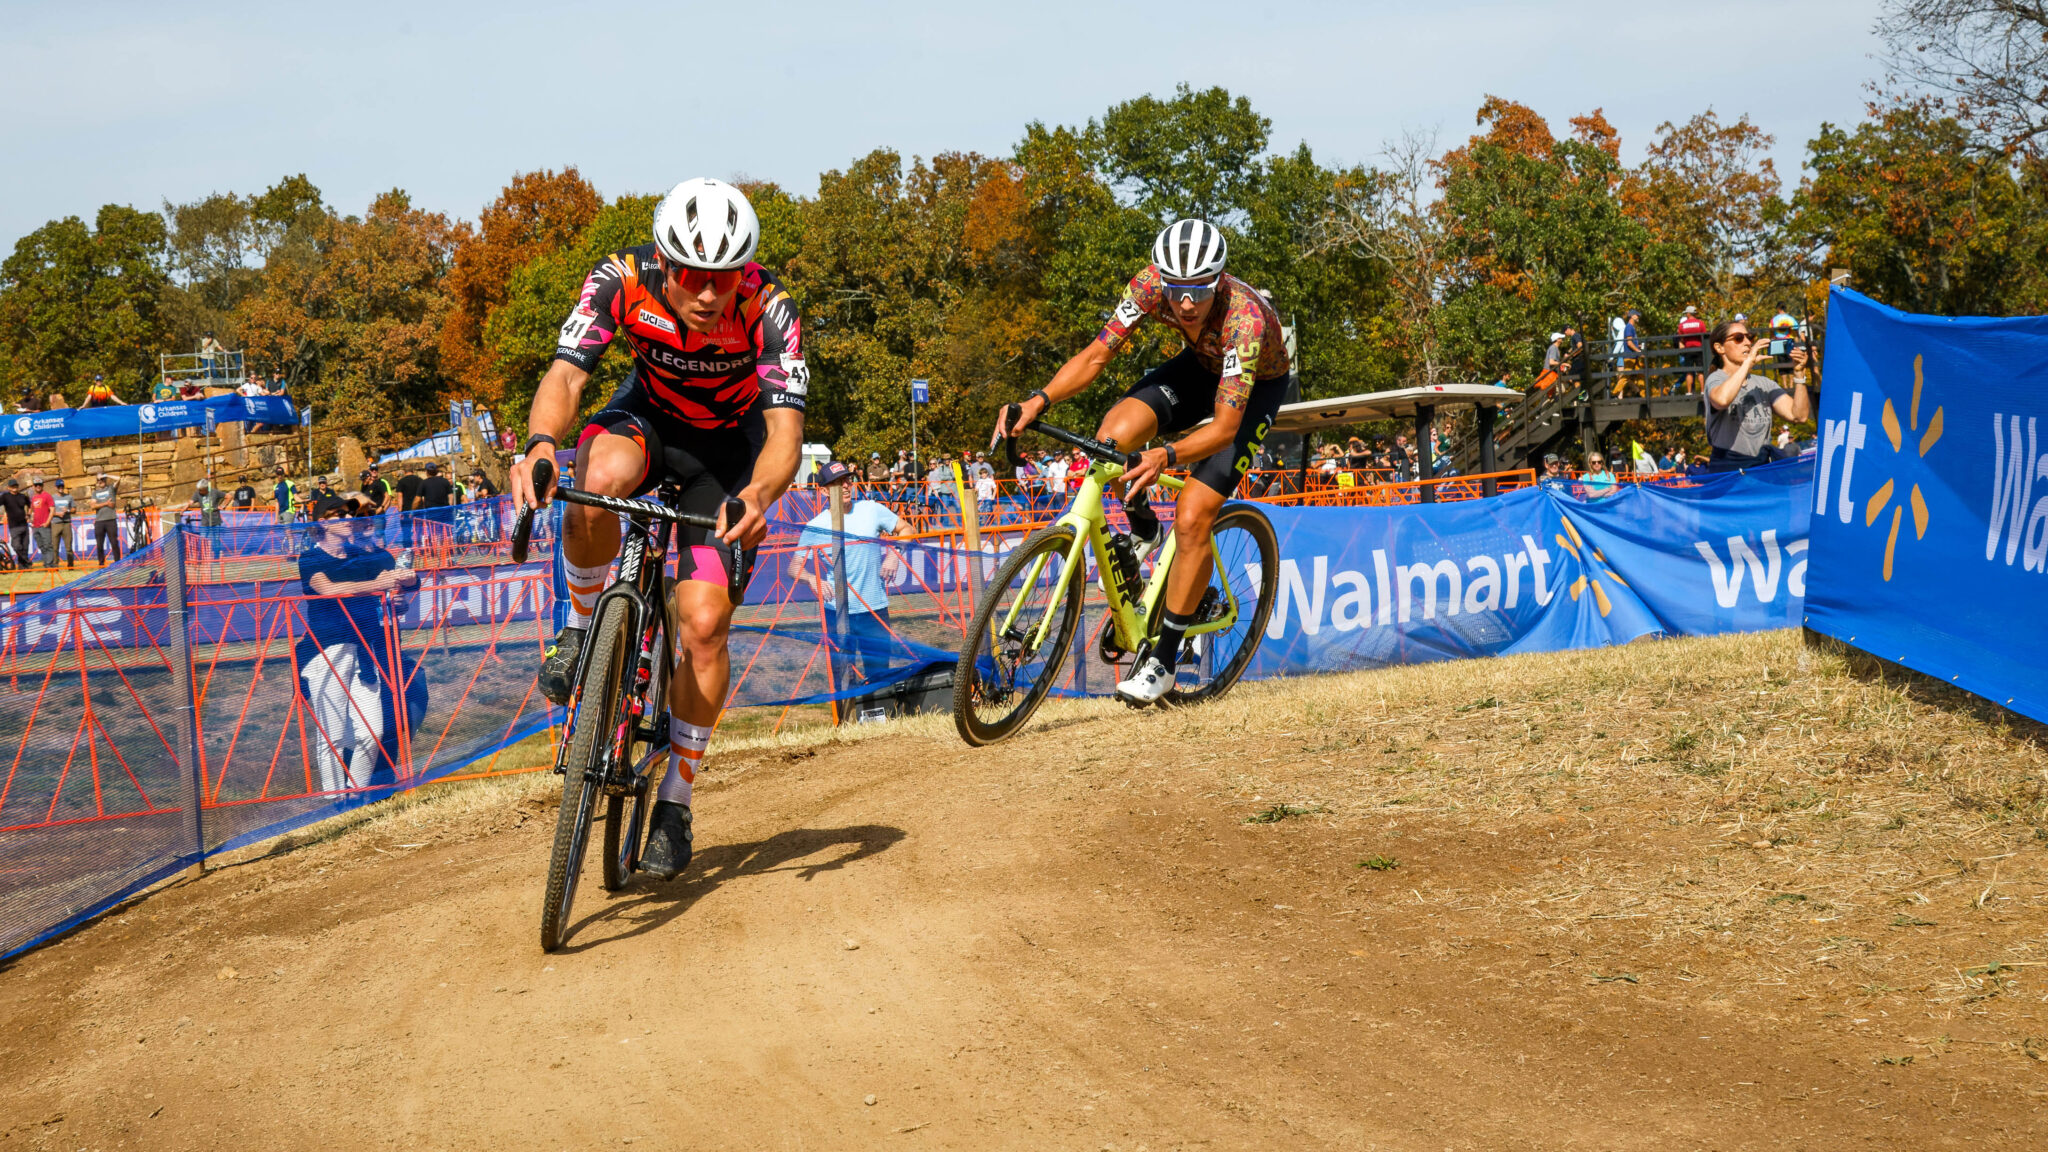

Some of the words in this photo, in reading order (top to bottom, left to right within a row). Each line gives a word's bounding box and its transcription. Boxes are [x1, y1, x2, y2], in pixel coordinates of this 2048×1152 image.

[1121, 301, 1139, 318] 27
[643, 312, 658, 326] UCI
[563, 319, 585, 338] 41
[651, 348, 752, 373] LEGENDRE
[1225, 353, 1237, 370] 27
[791, 366, 808, 384] 41
[33, 417, 64, 425] Arkansas
[602, 495, 677, 518] CANYON
[1243, 534, 1552, 640] Walmart
